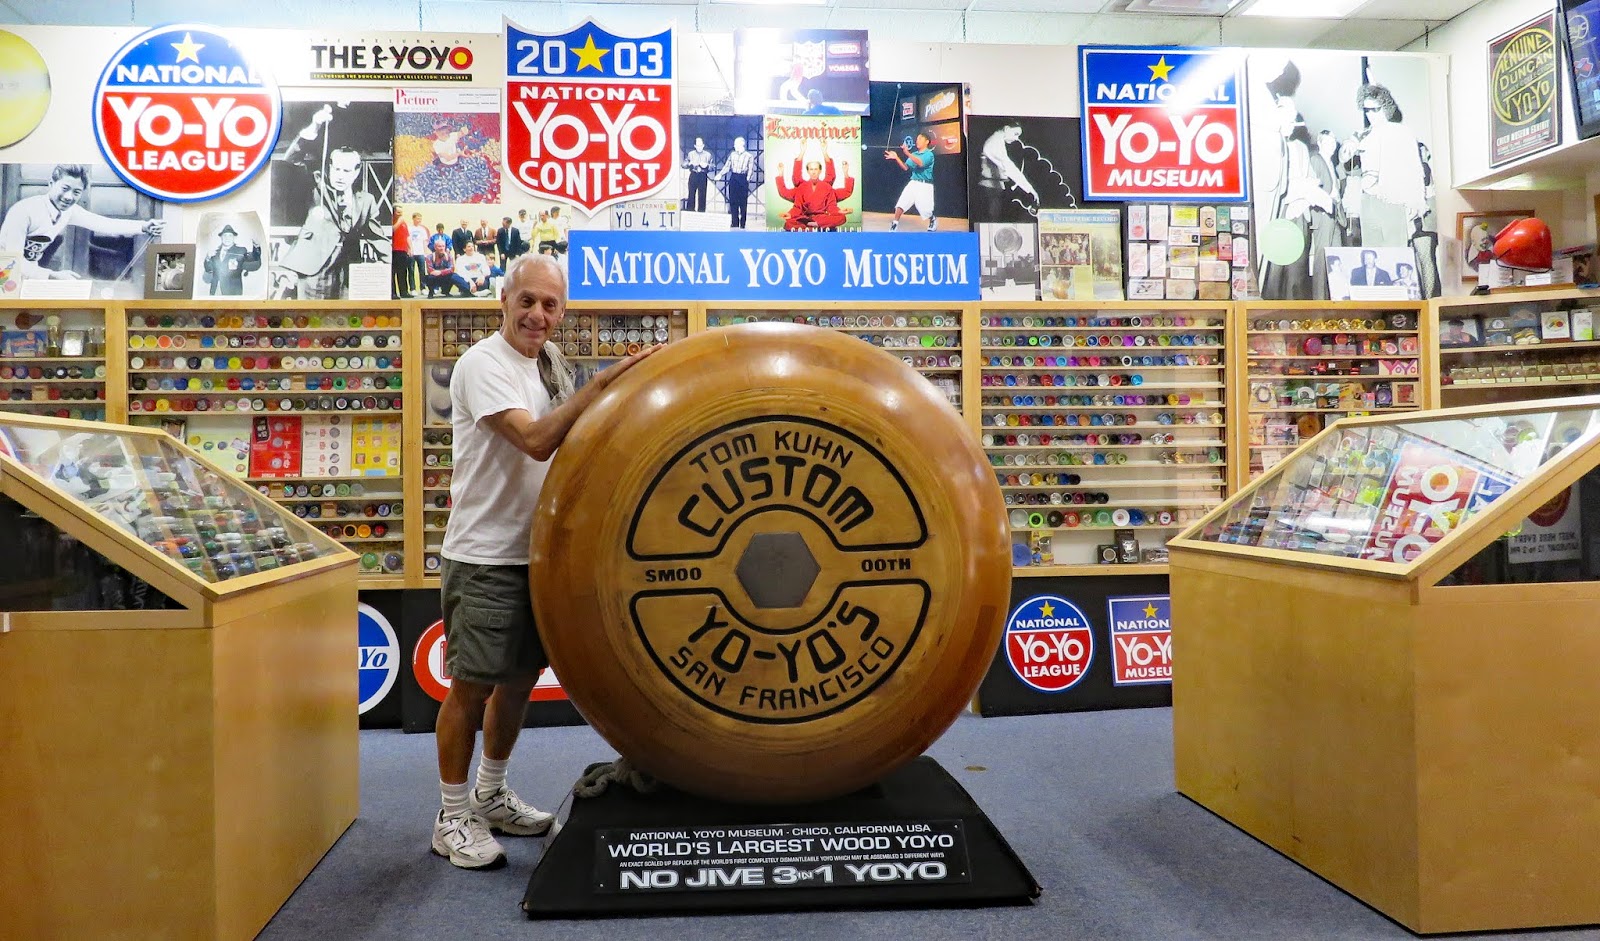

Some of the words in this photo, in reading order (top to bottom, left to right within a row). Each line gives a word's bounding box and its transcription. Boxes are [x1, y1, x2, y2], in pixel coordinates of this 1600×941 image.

[311, 45, 366, 68] THE
[389, 46, 474, 70] YOYO
[516, 39, 566, 74] 20
[614, 42, 663, 76] 03
[117, 64, 261, 85] NATIONAL
[1500, 48, 1553, 91] DUNCAN
[396, 88, 438, 105] Picture
[520, 86, 660, 102] NATIONAL
[1096, 82, 1230, 102] NATIOAL
[766, 117, 860, 140] Examiner
[128, 151, 246, 172] LEAGUE
[519, 160, 660, 203] CONTEST
[1106, 168, 1224, 187] MUSEUM
[616, 212, 632, 228] YO
[642, 212, 650, 228] 4
[659, 212, 676, 228] IT
[688, 432, 757, 474] TOM
[774, 430, 854, 470] KUHN
[677, 454, 875, 538] CUSTOM
[645, 567, 702, 582] SMOO
[861, 558, 912, 572] OOTH
[1016, 618, 1080, 628] NATIONAL
[1117, 619, 1170, 630] NATION
[688, 600, 881, 684] YO-YO'S
[668, 646, 727, 696] SAN
[739, 636, 895, 710] FRANCISCO
[1024, 664, 1081, 678] LEAGUE
[1125, 666, 1172, 678] MUSEU
[630, 832, 690, 841] NATIONAL
[693, 830, 725, 838] YOYO
[728, 828, 783, 838] MUSEUM
[792, 828, 832, 836] CHICO,
[834, 825, 904, 834] CALIFORNIA
[906, 824, 932, 832] USA
[608, 842, 711, 858] WORLD'S
[718, 838, 814, 854] LARGEST
[820, 836, 890, 851] WOOD
[896, 834, 954, 848] YOYO
[620, 869, 680, 890] NO
[685, 867, 765, 887] JIVE
[844, 862, 948, 882] YOYO
